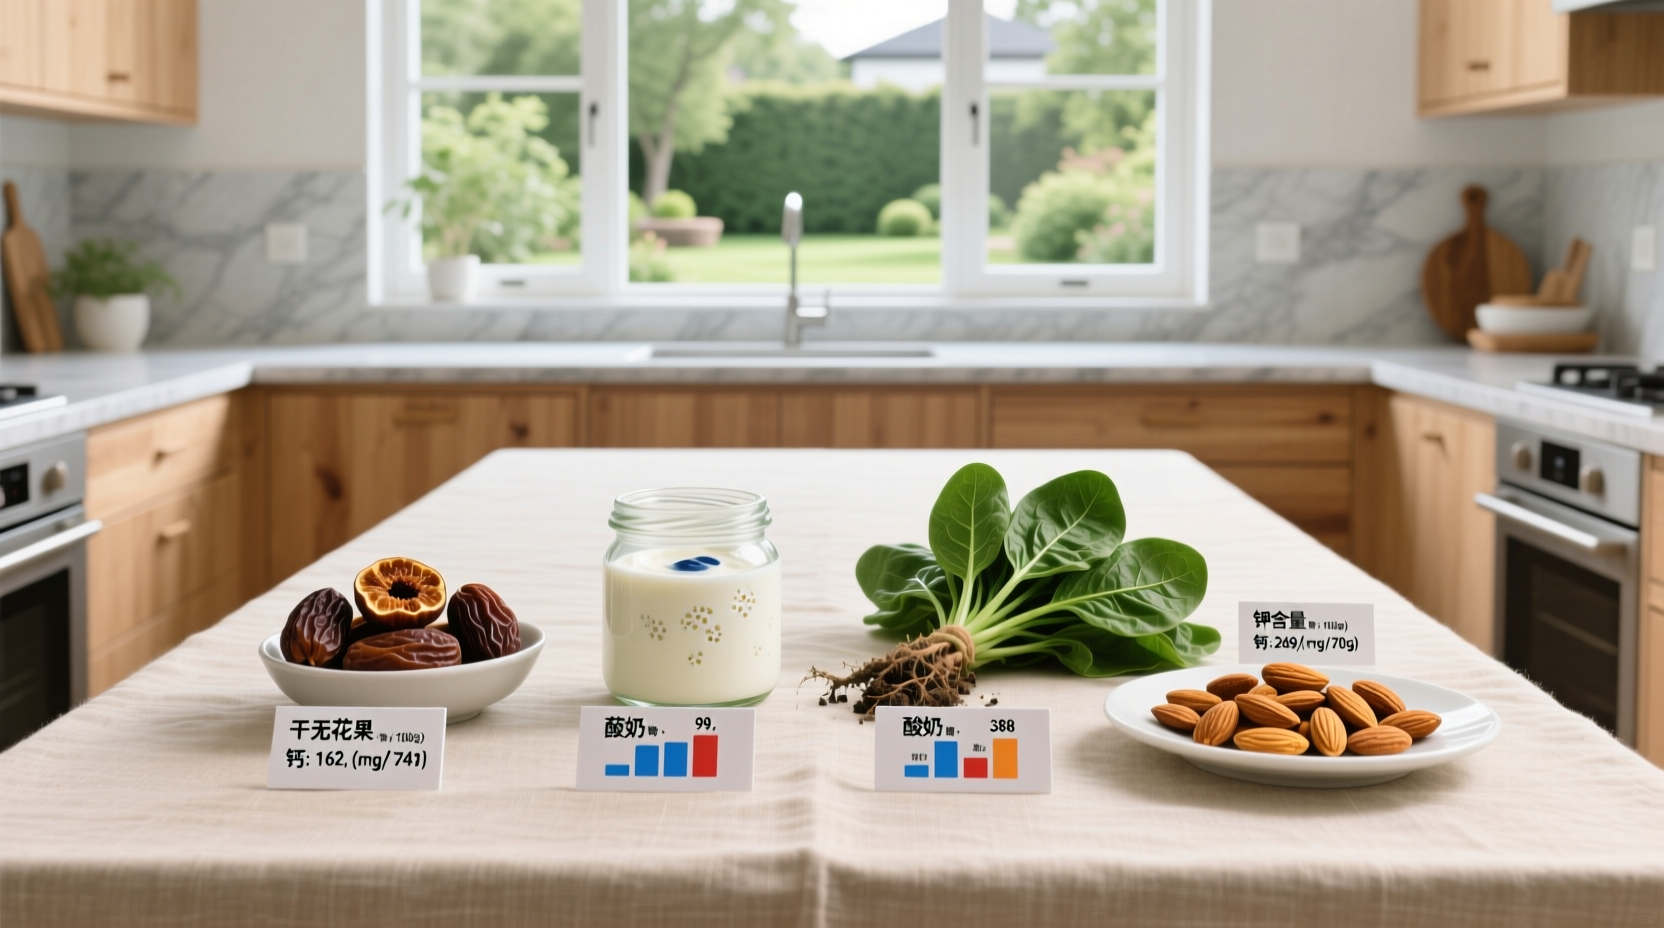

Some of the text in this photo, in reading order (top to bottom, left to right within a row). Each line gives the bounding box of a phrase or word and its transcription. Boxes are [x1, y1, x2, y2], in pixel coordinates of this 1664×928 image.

[289, 718, 374, 741] 干无花果
[902, 716, 943, 737] 酸奶
[989, 719, 1015, 732] 388
